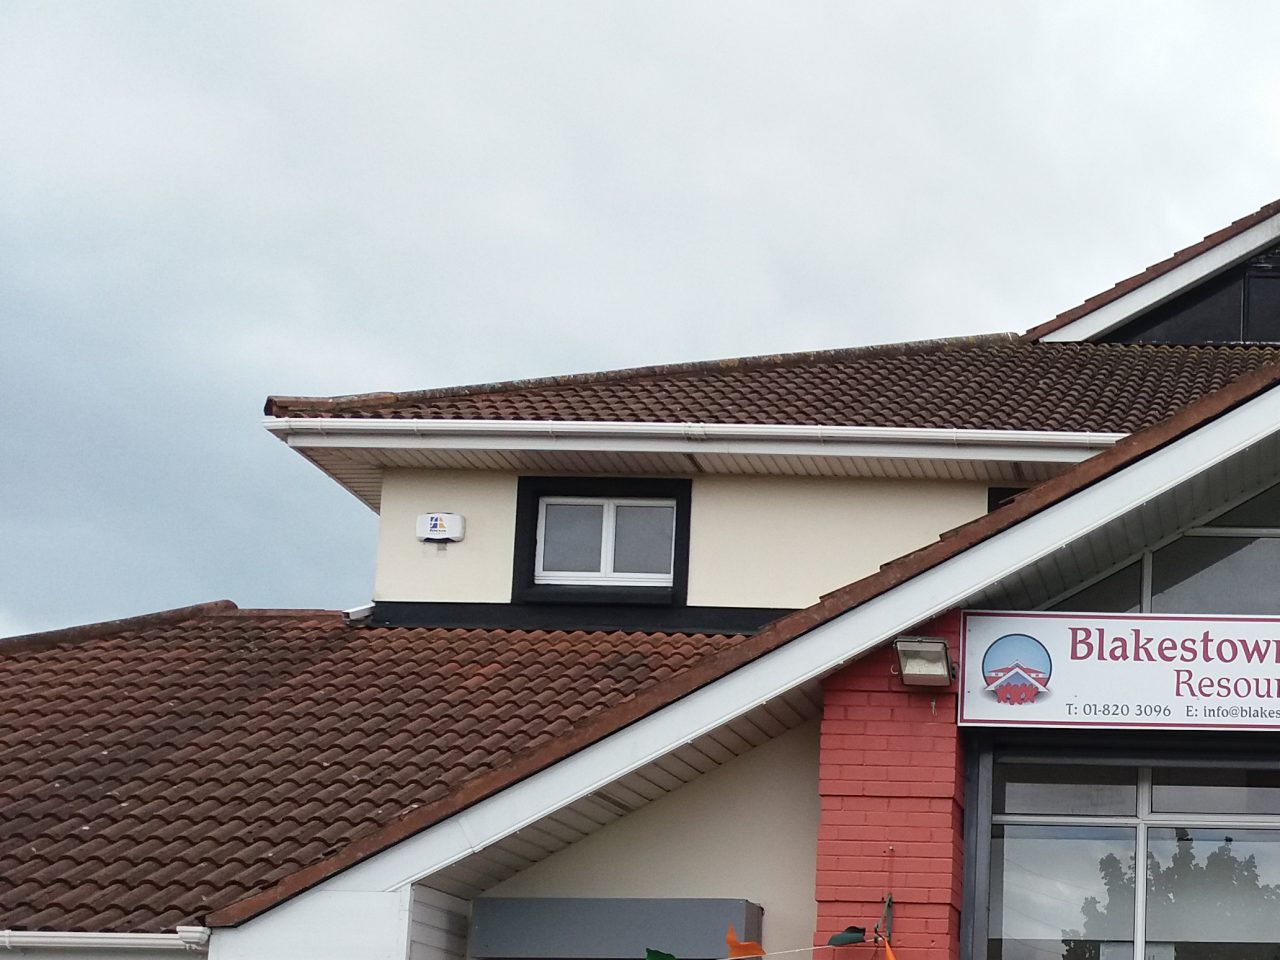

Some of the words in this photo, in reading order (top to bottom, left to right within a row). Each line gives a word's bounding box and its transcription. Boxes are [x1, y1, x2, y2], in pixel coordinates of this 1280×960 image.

[1065, 703, 1078, 716] T:
[1083, 703, 1130, 717] 01-820
[1134, 704, 1172, 718] 3096
[1186, 706, 1198, 717] E:
